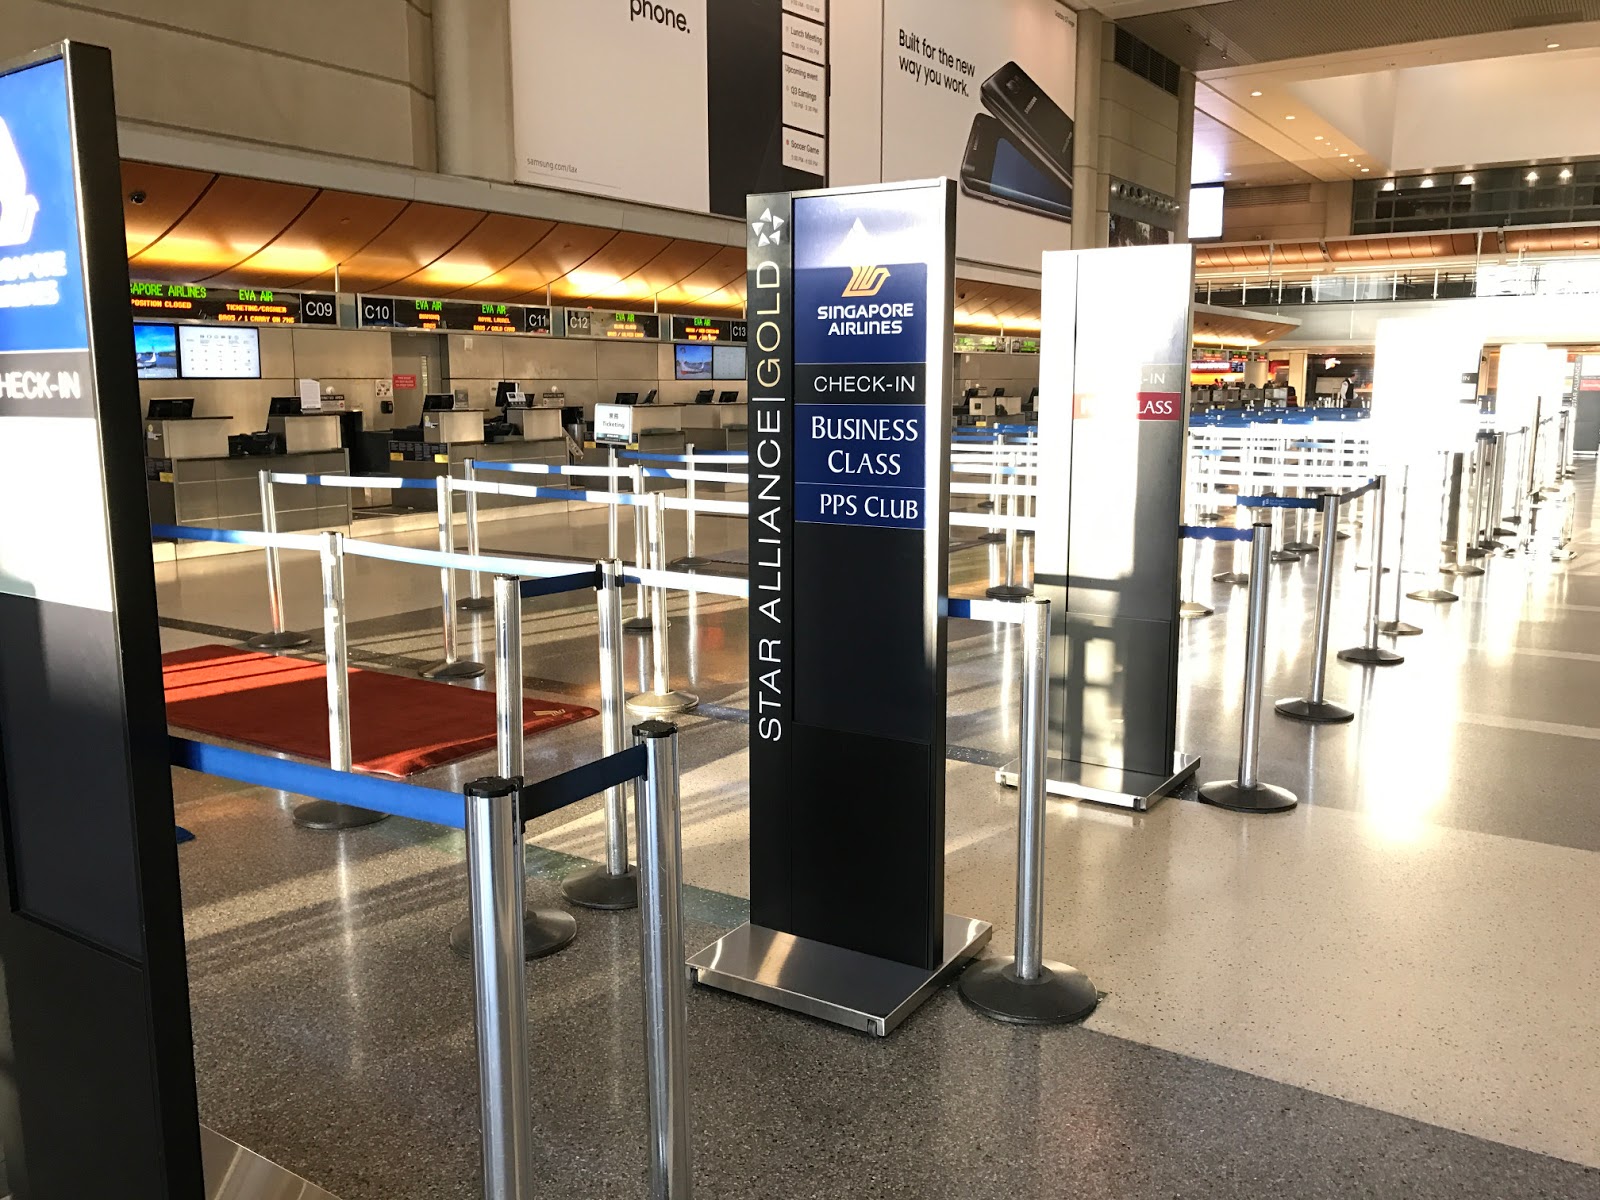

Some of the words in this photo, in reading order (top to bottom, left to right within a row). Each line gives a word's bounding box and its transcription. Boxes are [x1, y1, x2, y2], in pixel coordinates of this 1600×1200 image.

[630, 0, 690, 34] phone.
[790, 26, 804, 38] Lunch
[804, 31, 822, 46] Meeting
[899, 28, 920, 54] Built
[922, 38, 936, 60] for
[938, 47, 954, 68] the
[955, 57, 976, 78] new
[785, 64, 806, 79] Upcoming
[806, 72, 818, 81] event
[899, 55, 922, 82] way
[924, 66, 942, 86] you
[944, 74, 969, 98] work.
[790, 86, 798, 95] Q3
[798, 88, 817, 102] Earnings
[790, 140, 806, 151] Soccer
[806, 144, 820, 155] Game
[526, 158, 578, 174] samsung.com/lax
[168, 285, 207, 299] AIRLINES
[239, 289, 256, 302] EVA
[260, 290, 274, 302] AIR
[131, 299, 162, 308] POSITION
[164, 300, 192, 309] CLOSED
[306, 301, 333, 317] C09
[365, 304, 390, 320] C10
[415, 300, 429, 310] EVA
[432, 301, 442, 311] AIR
[481, 304, 495, 314] EVA
[496, 305, 507, 315] AIR
[817, 303, 914, 320] SINGAPORE
[528, 314, 546, 327] C11
[570, 316, 588, 329] C12
[756, 260, 781, 388] GOLD
[827, 320, 903, 336] AIRLINES
[732, 326, 746, 337] C13
[813, 375, 915, 392] CHECK-IN
[602, 420, 625, 429] Ticketing
[811, 415, 919, 442] BUSINESS
[827, 449, 901, 476] CLASS
[820, 493, 858, 516] PPS
[864, 495, 919, 520] CLUB
[757, 410, 781, 624] ALLIANCE
[758, 638, 782, 742] STAR
